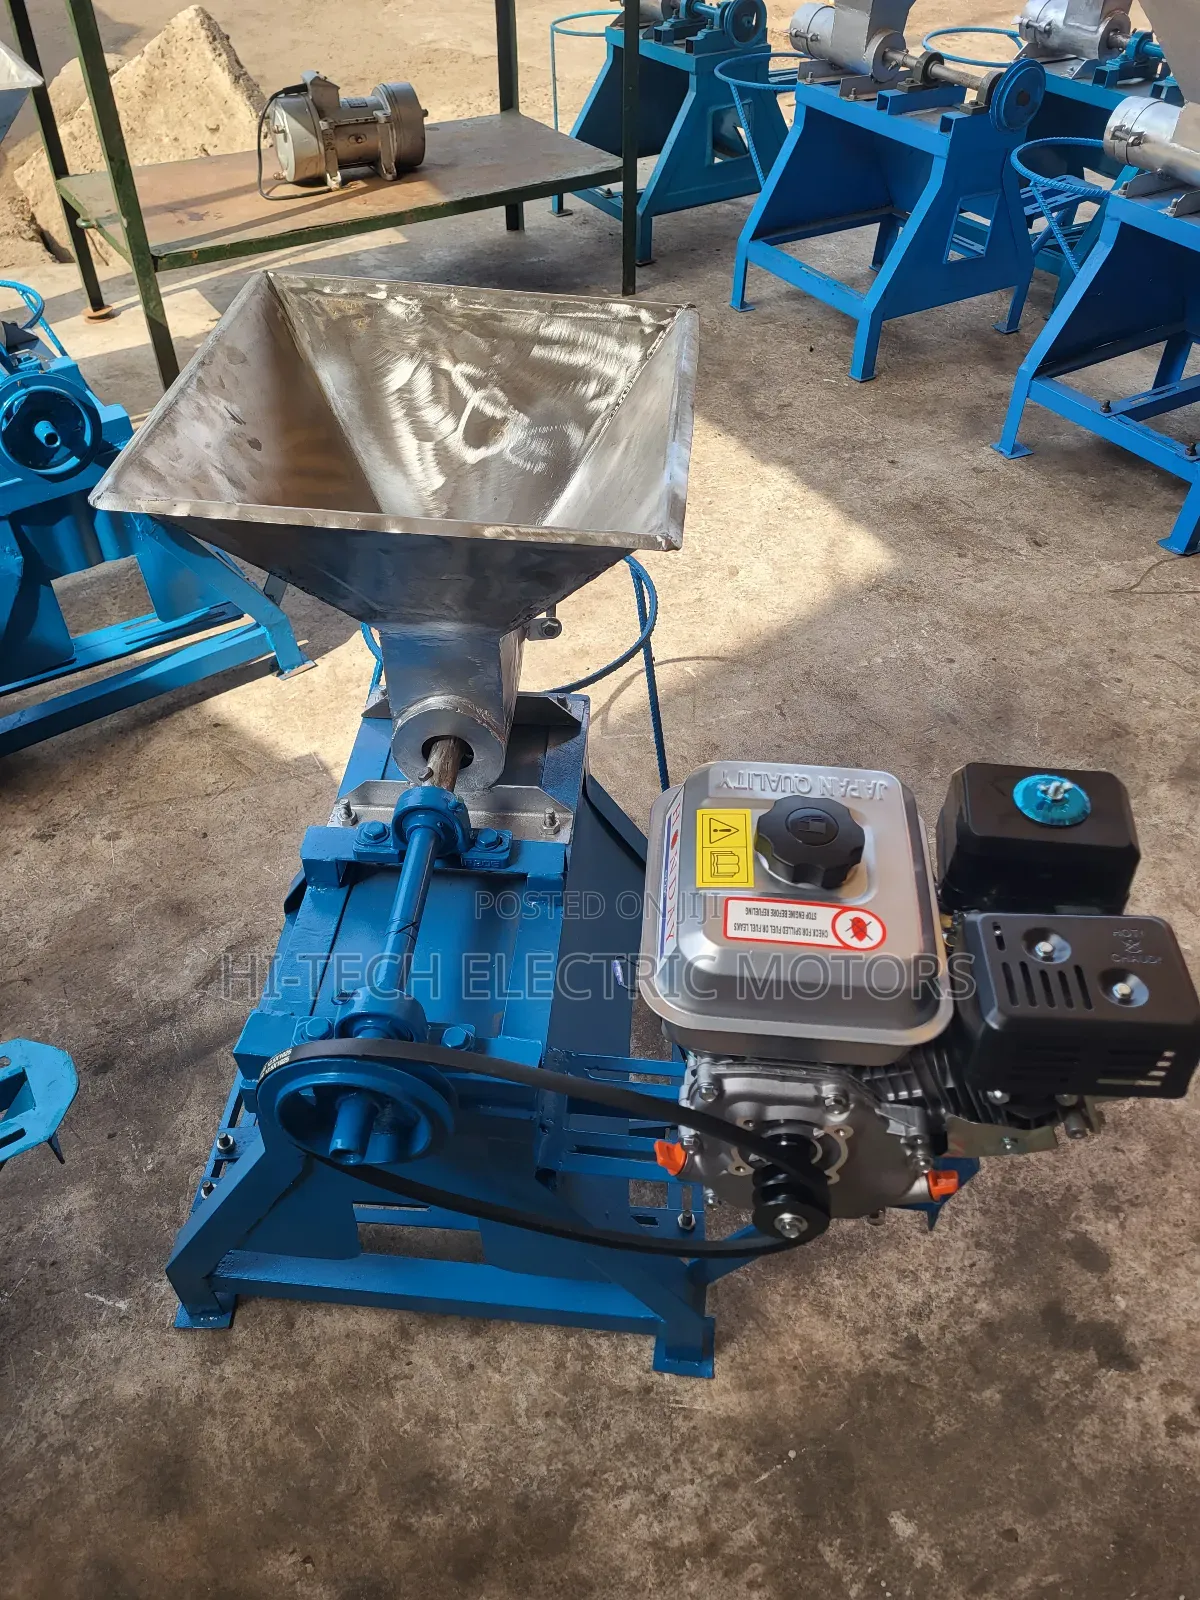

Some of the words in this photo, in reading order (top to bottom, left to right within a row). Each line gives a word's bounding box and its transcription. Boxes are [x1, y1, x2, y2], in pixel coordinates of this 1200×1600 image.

[717, 769, 813, 795] QUALITY
[818, 775, 889, 801] JAPAN
[745, 907, 770, 917] REFUELING
[770, 908, 788, 919] BEFORE
[788, 910, 805, 920] ENGINE
[805, 911, 817, 921] STOP
[733, 922, 749, 932] LEAKS
[749, 923, 761, 933] FUEL
[762, 924, 769, 934] OR
[770, 925, 782, 935] FUEL
[782, 925, 802, 936] SPILLED
[802, 927, 811, 937] FOR
[813, 929, 829, 939] CHECK
